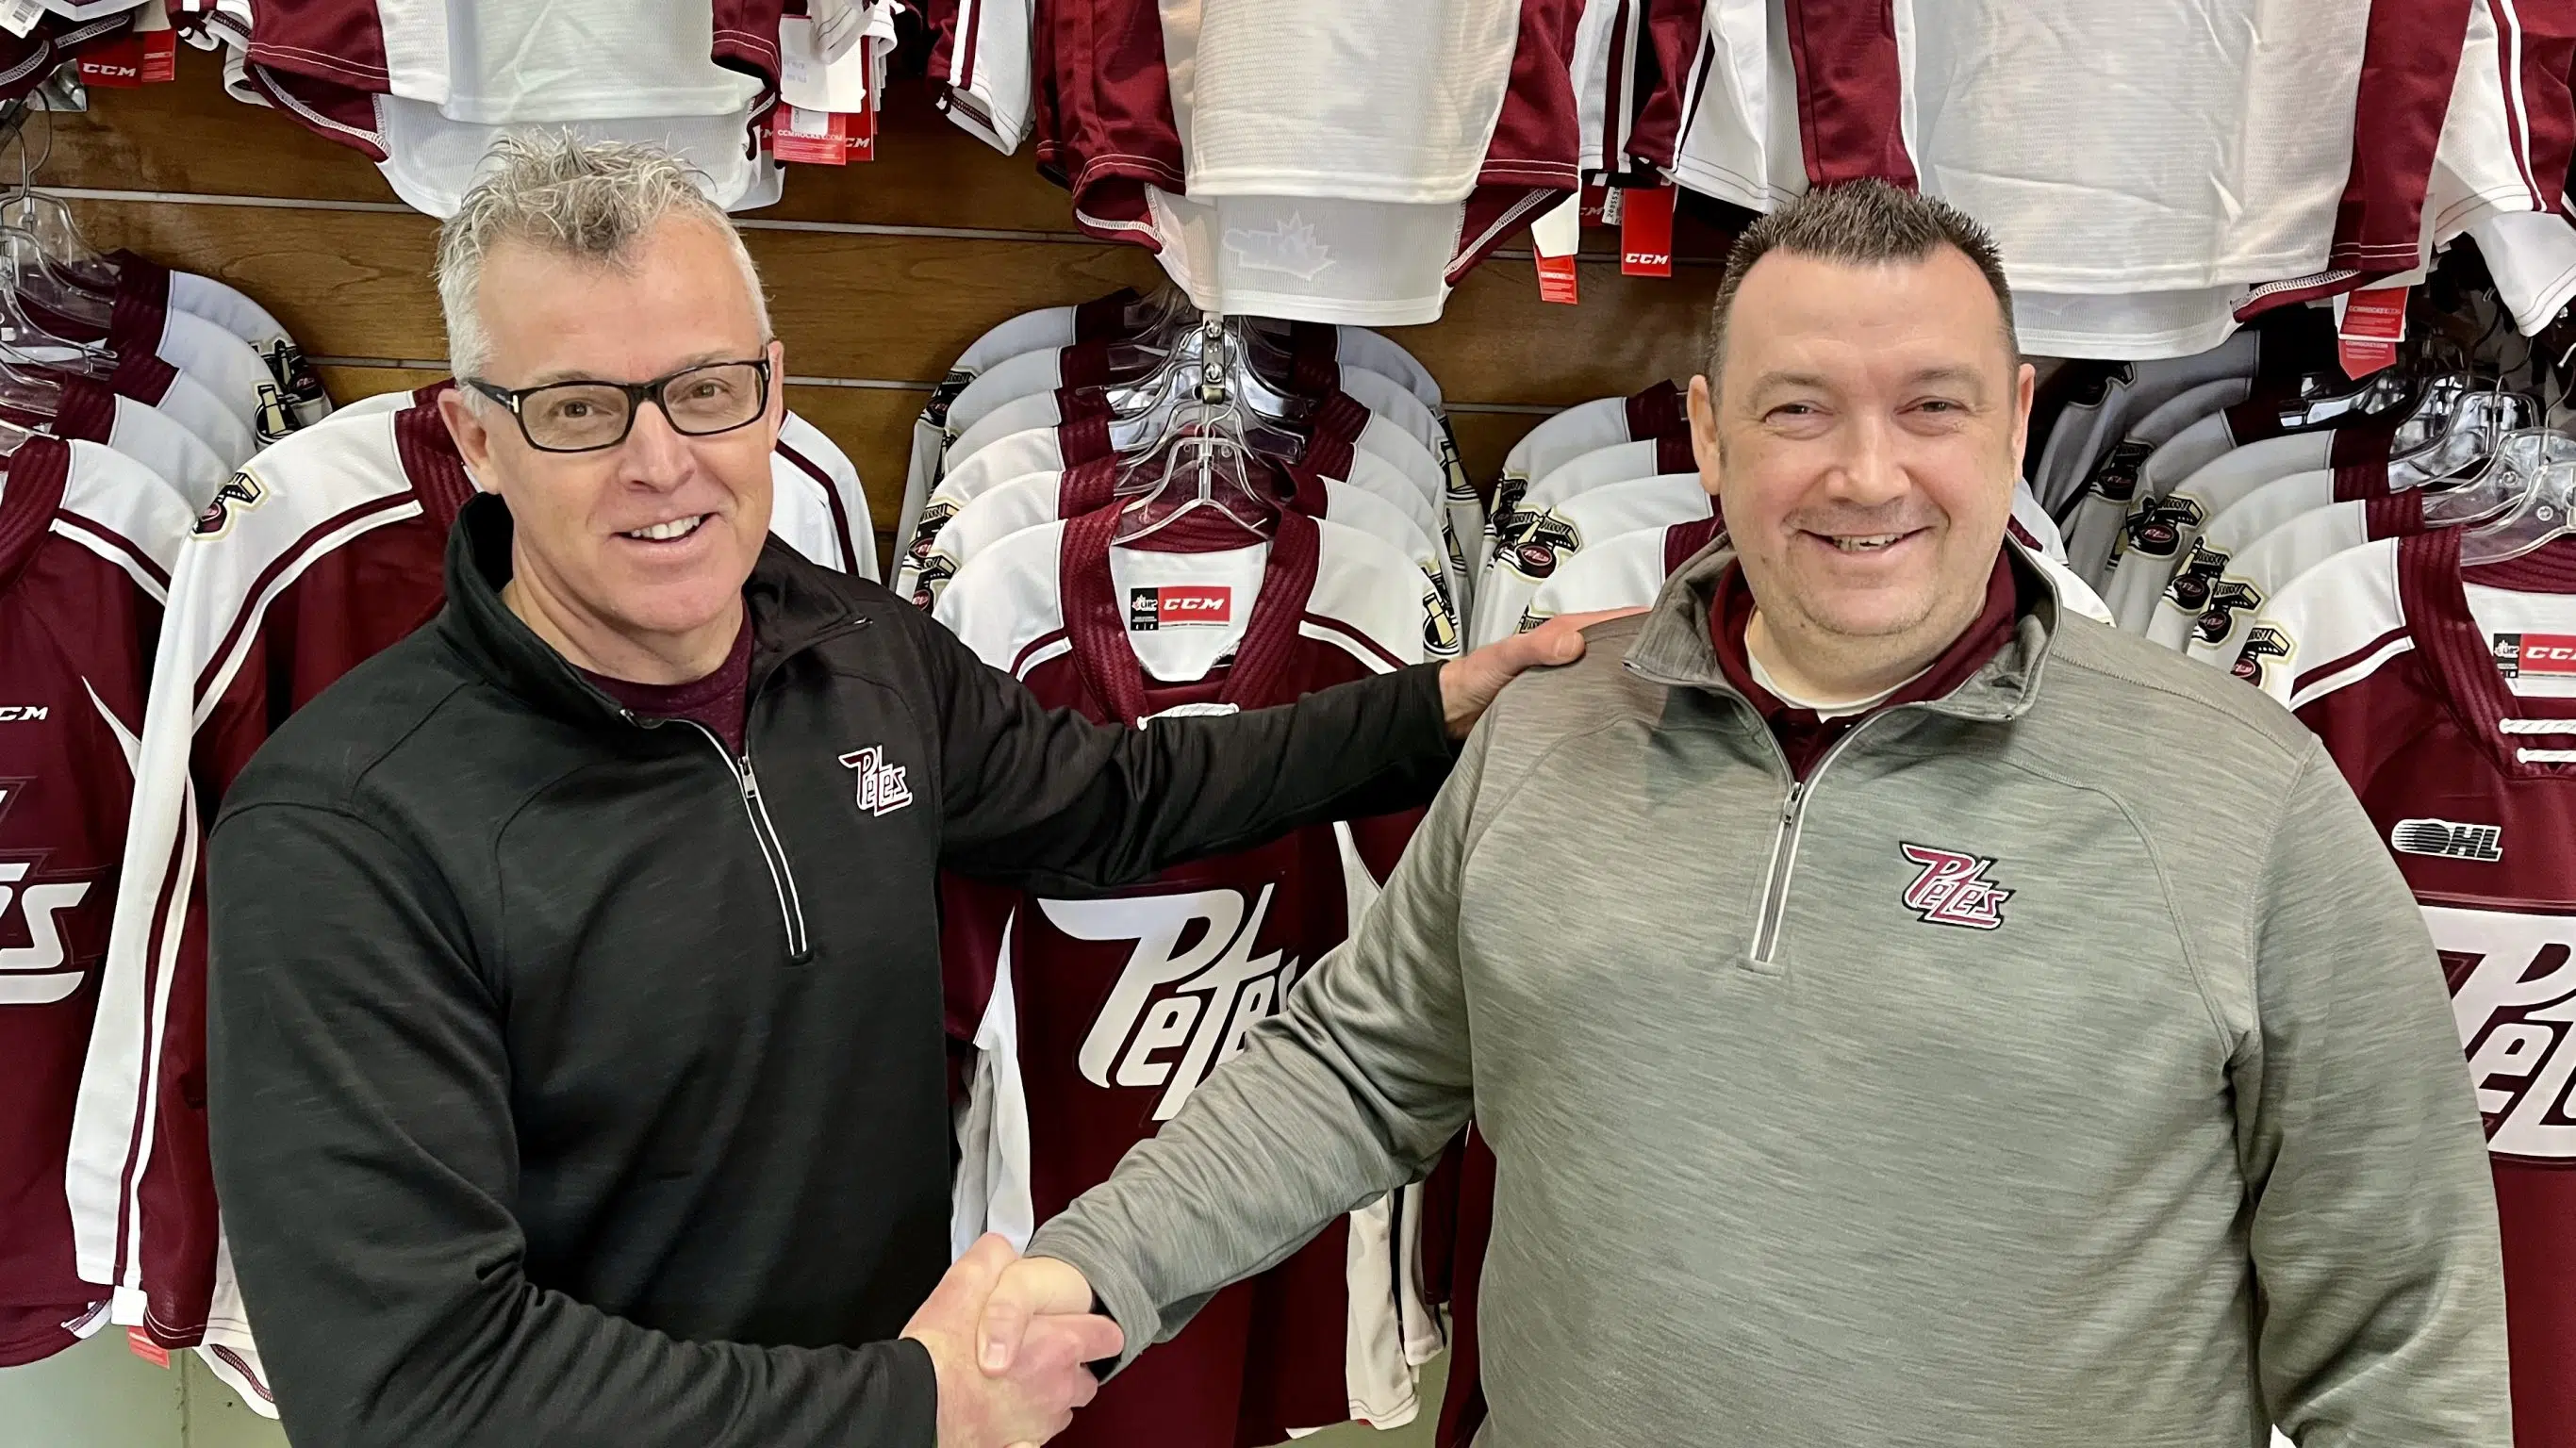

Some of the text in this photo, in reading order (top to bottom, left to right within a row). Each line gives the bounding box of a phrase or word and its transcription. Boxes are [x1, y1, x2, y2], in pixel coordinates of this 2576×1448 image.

[83, 62, 136, 77] CCM
[845, 137, 870, 148] CM
[1579, 206, 1604, 216] CM
[1625, 253, 1669, 265] CCM
[1163, 598, 1225, 611] CCM
[2525, 647, 2576, 660] CC
[0, 706, 49, 721] CM
[2391, 818, 2502, 862] OHL
